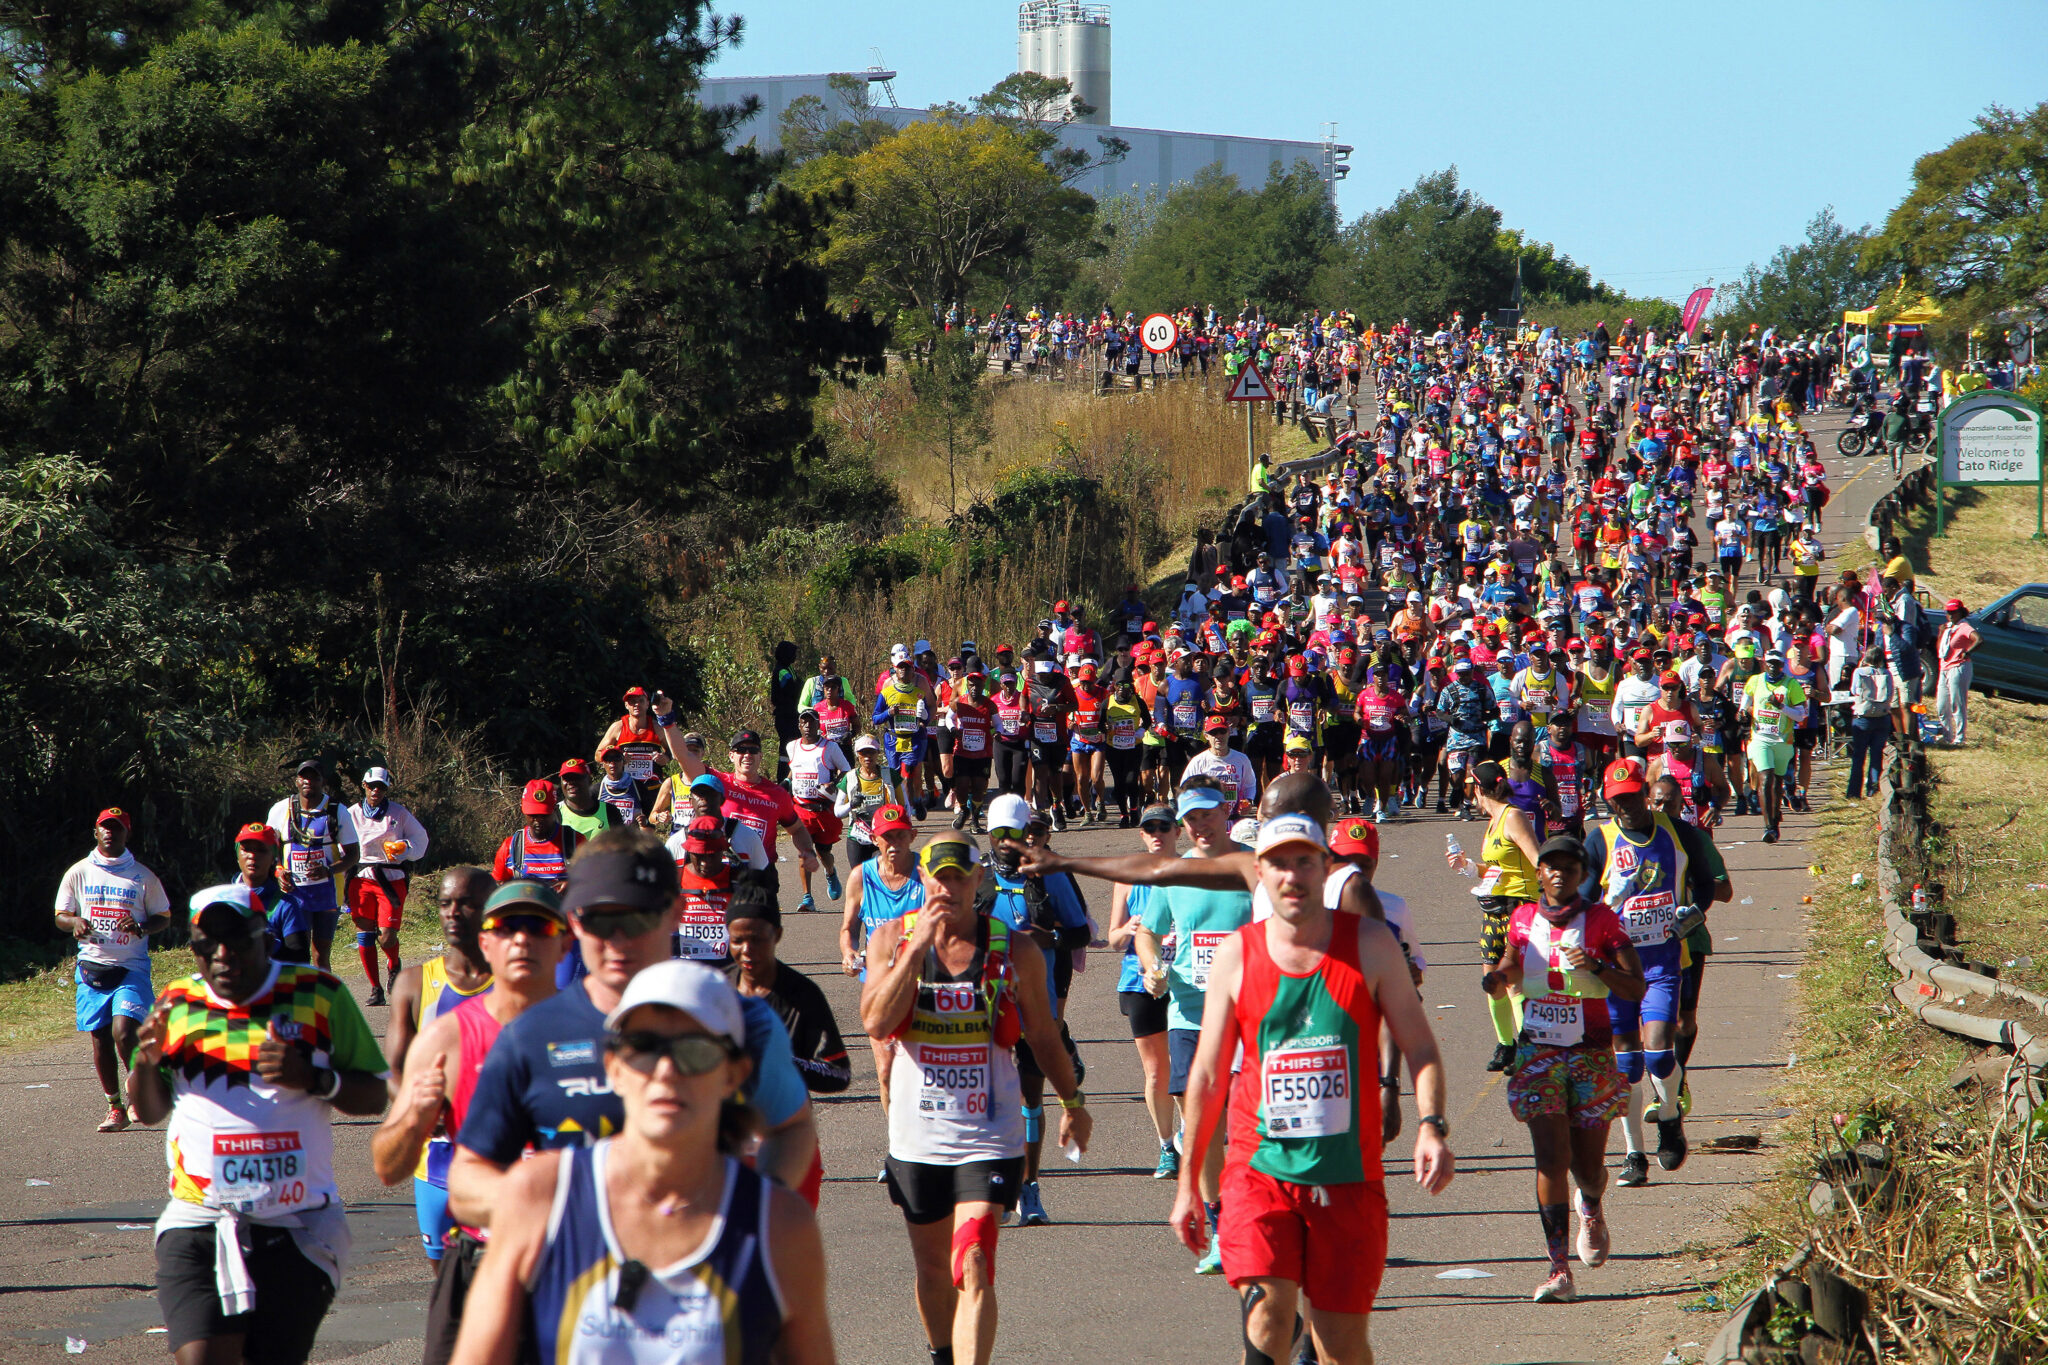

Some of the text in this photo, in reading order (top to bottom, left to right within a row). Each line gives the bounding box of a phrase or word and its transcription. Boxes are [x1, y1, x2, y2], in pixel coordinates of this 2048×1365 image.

[1149, 326, 1167, 342] 60
[1956, 447, 2025, 458] Welcome to
[1957, 460, 2023, 473] Cato Ridge
[628, 761, 650, 769] F51999
[728, 789, 780, 810] TEAM VITALITY
[1615, 849, 1634, 869] 60
[85, 885, 137, 899] MAFIKENG
[1630, 897, 1669, 910] THIRSTI
[93, 909, 127, 918] THIRST
[1629, 906, 1674, 928] F26796
[116, 934, 129, 945] 40
[684, 926, 724, 940] F15033
[711, 942, 727, 956] 40
[936, 987, 974, 1012] 60
[1530, 1003, 1577, 1024] F49193
[923, 1051, 984, 1061] THIRSTI
[1270, 1056, 1342, 1070] THIRSTI
[924, 1067, 984, 1089] D50551
[1271, 1074, 1344, 1101] F55026
[967, 1092, 988, 1114] 60
[217, 1137, 296, 1152] THIRSTI
[222, 1155, 298, 1185] G41318
[278, 1181, 305, 1206] 40
